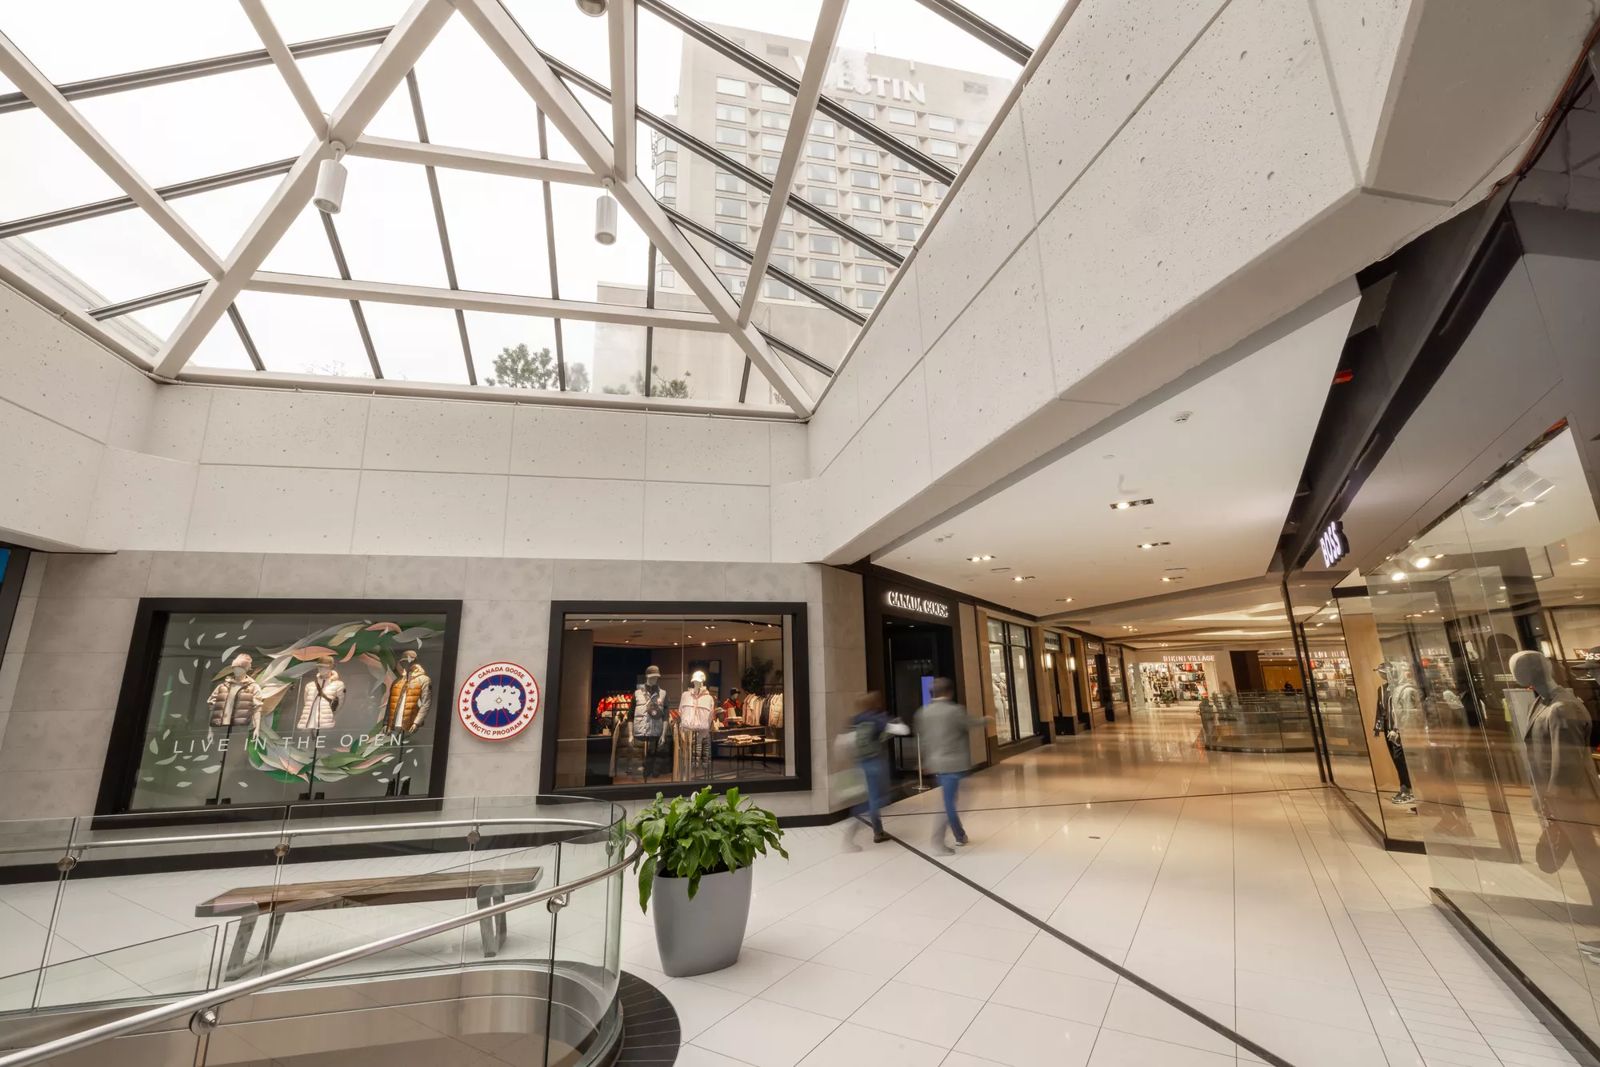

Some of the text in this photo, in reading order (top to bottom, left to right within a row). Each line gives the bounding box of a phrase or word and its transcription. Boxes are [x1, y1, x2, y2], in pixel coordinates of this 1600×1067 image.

[1320, 521, 1341, 568] BOSS
[887, 591, 923, 612] CANADA
[477, 666, 525, 679] CANADA GOOSE
[470, 720, 523, 736] ARCTIC PROGRAM
[173, 733, 402, 754] LIVE IN THE OPEN
